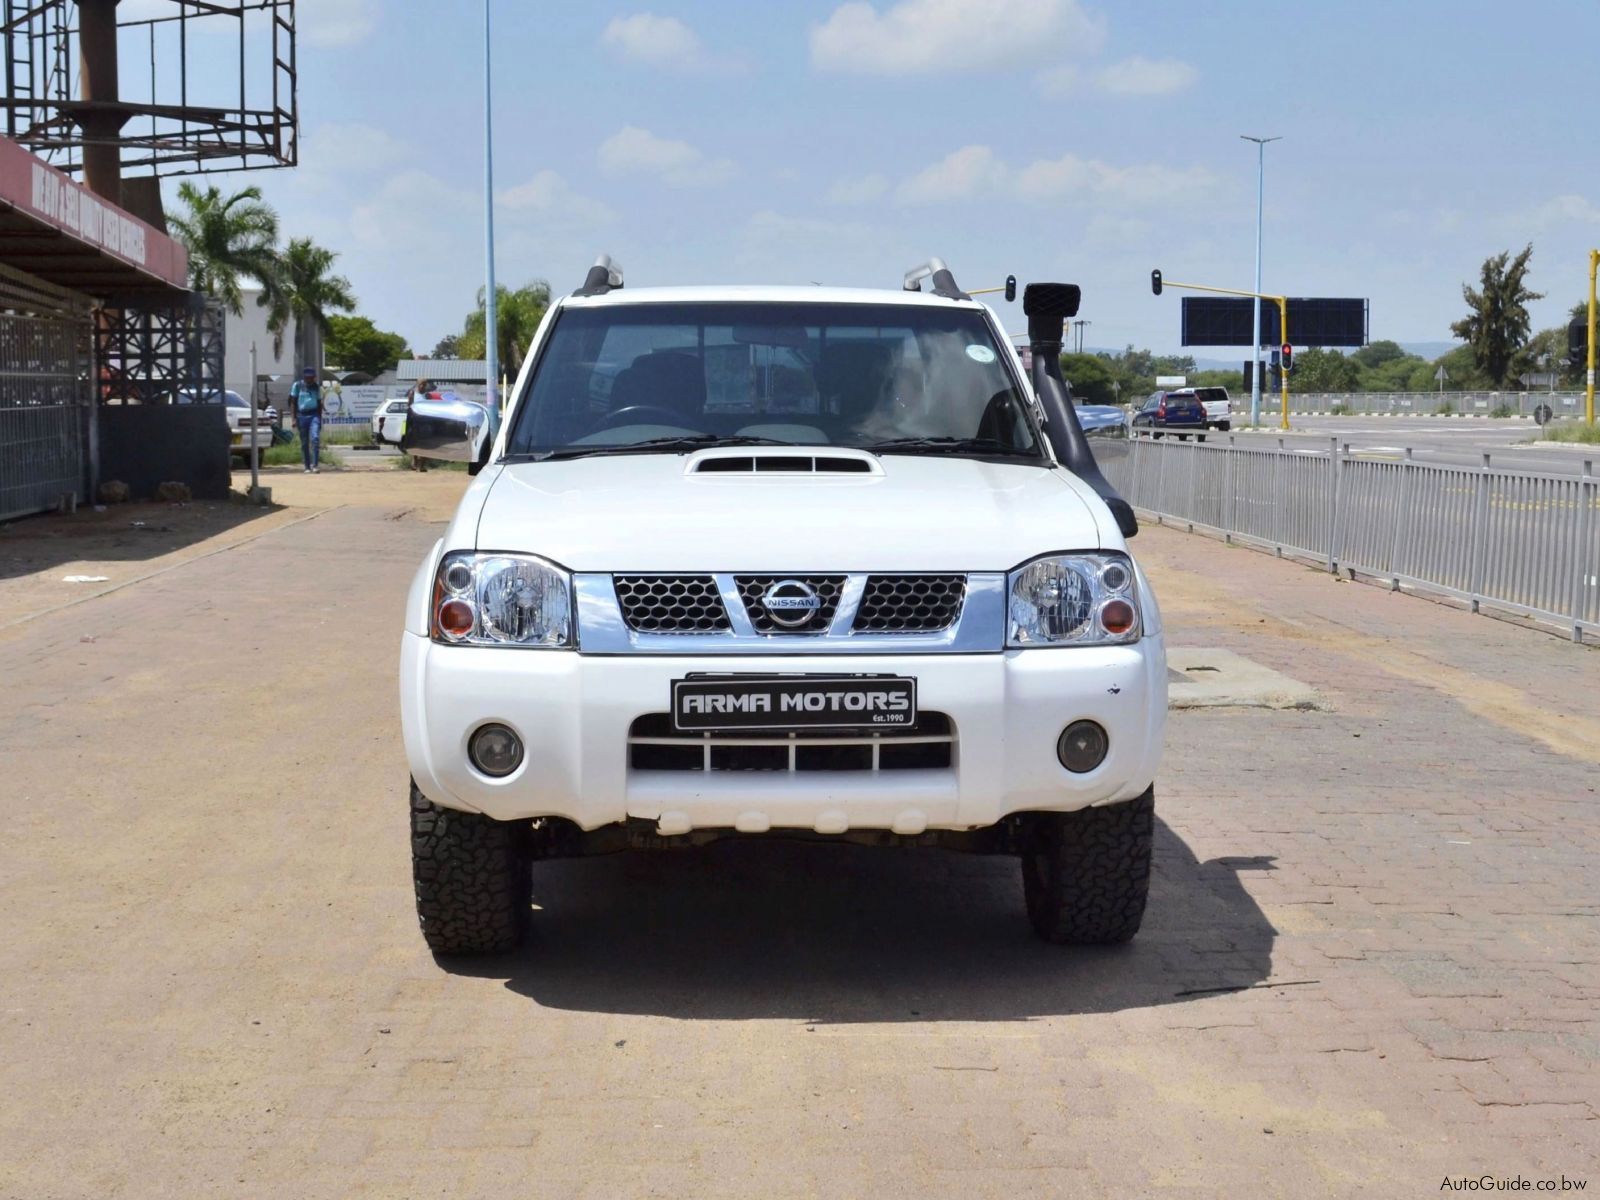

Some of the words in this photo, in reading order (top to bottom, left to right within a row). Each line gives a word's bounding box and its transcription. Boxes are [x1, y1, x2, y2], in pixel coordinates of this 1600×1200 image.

[768, 599, 815, 607] NISSAN
[682, 693, 771, 714] ARMA
[780, 692, 909, 711] MOTORS
[872, 714, 904, 723] Est.1990
